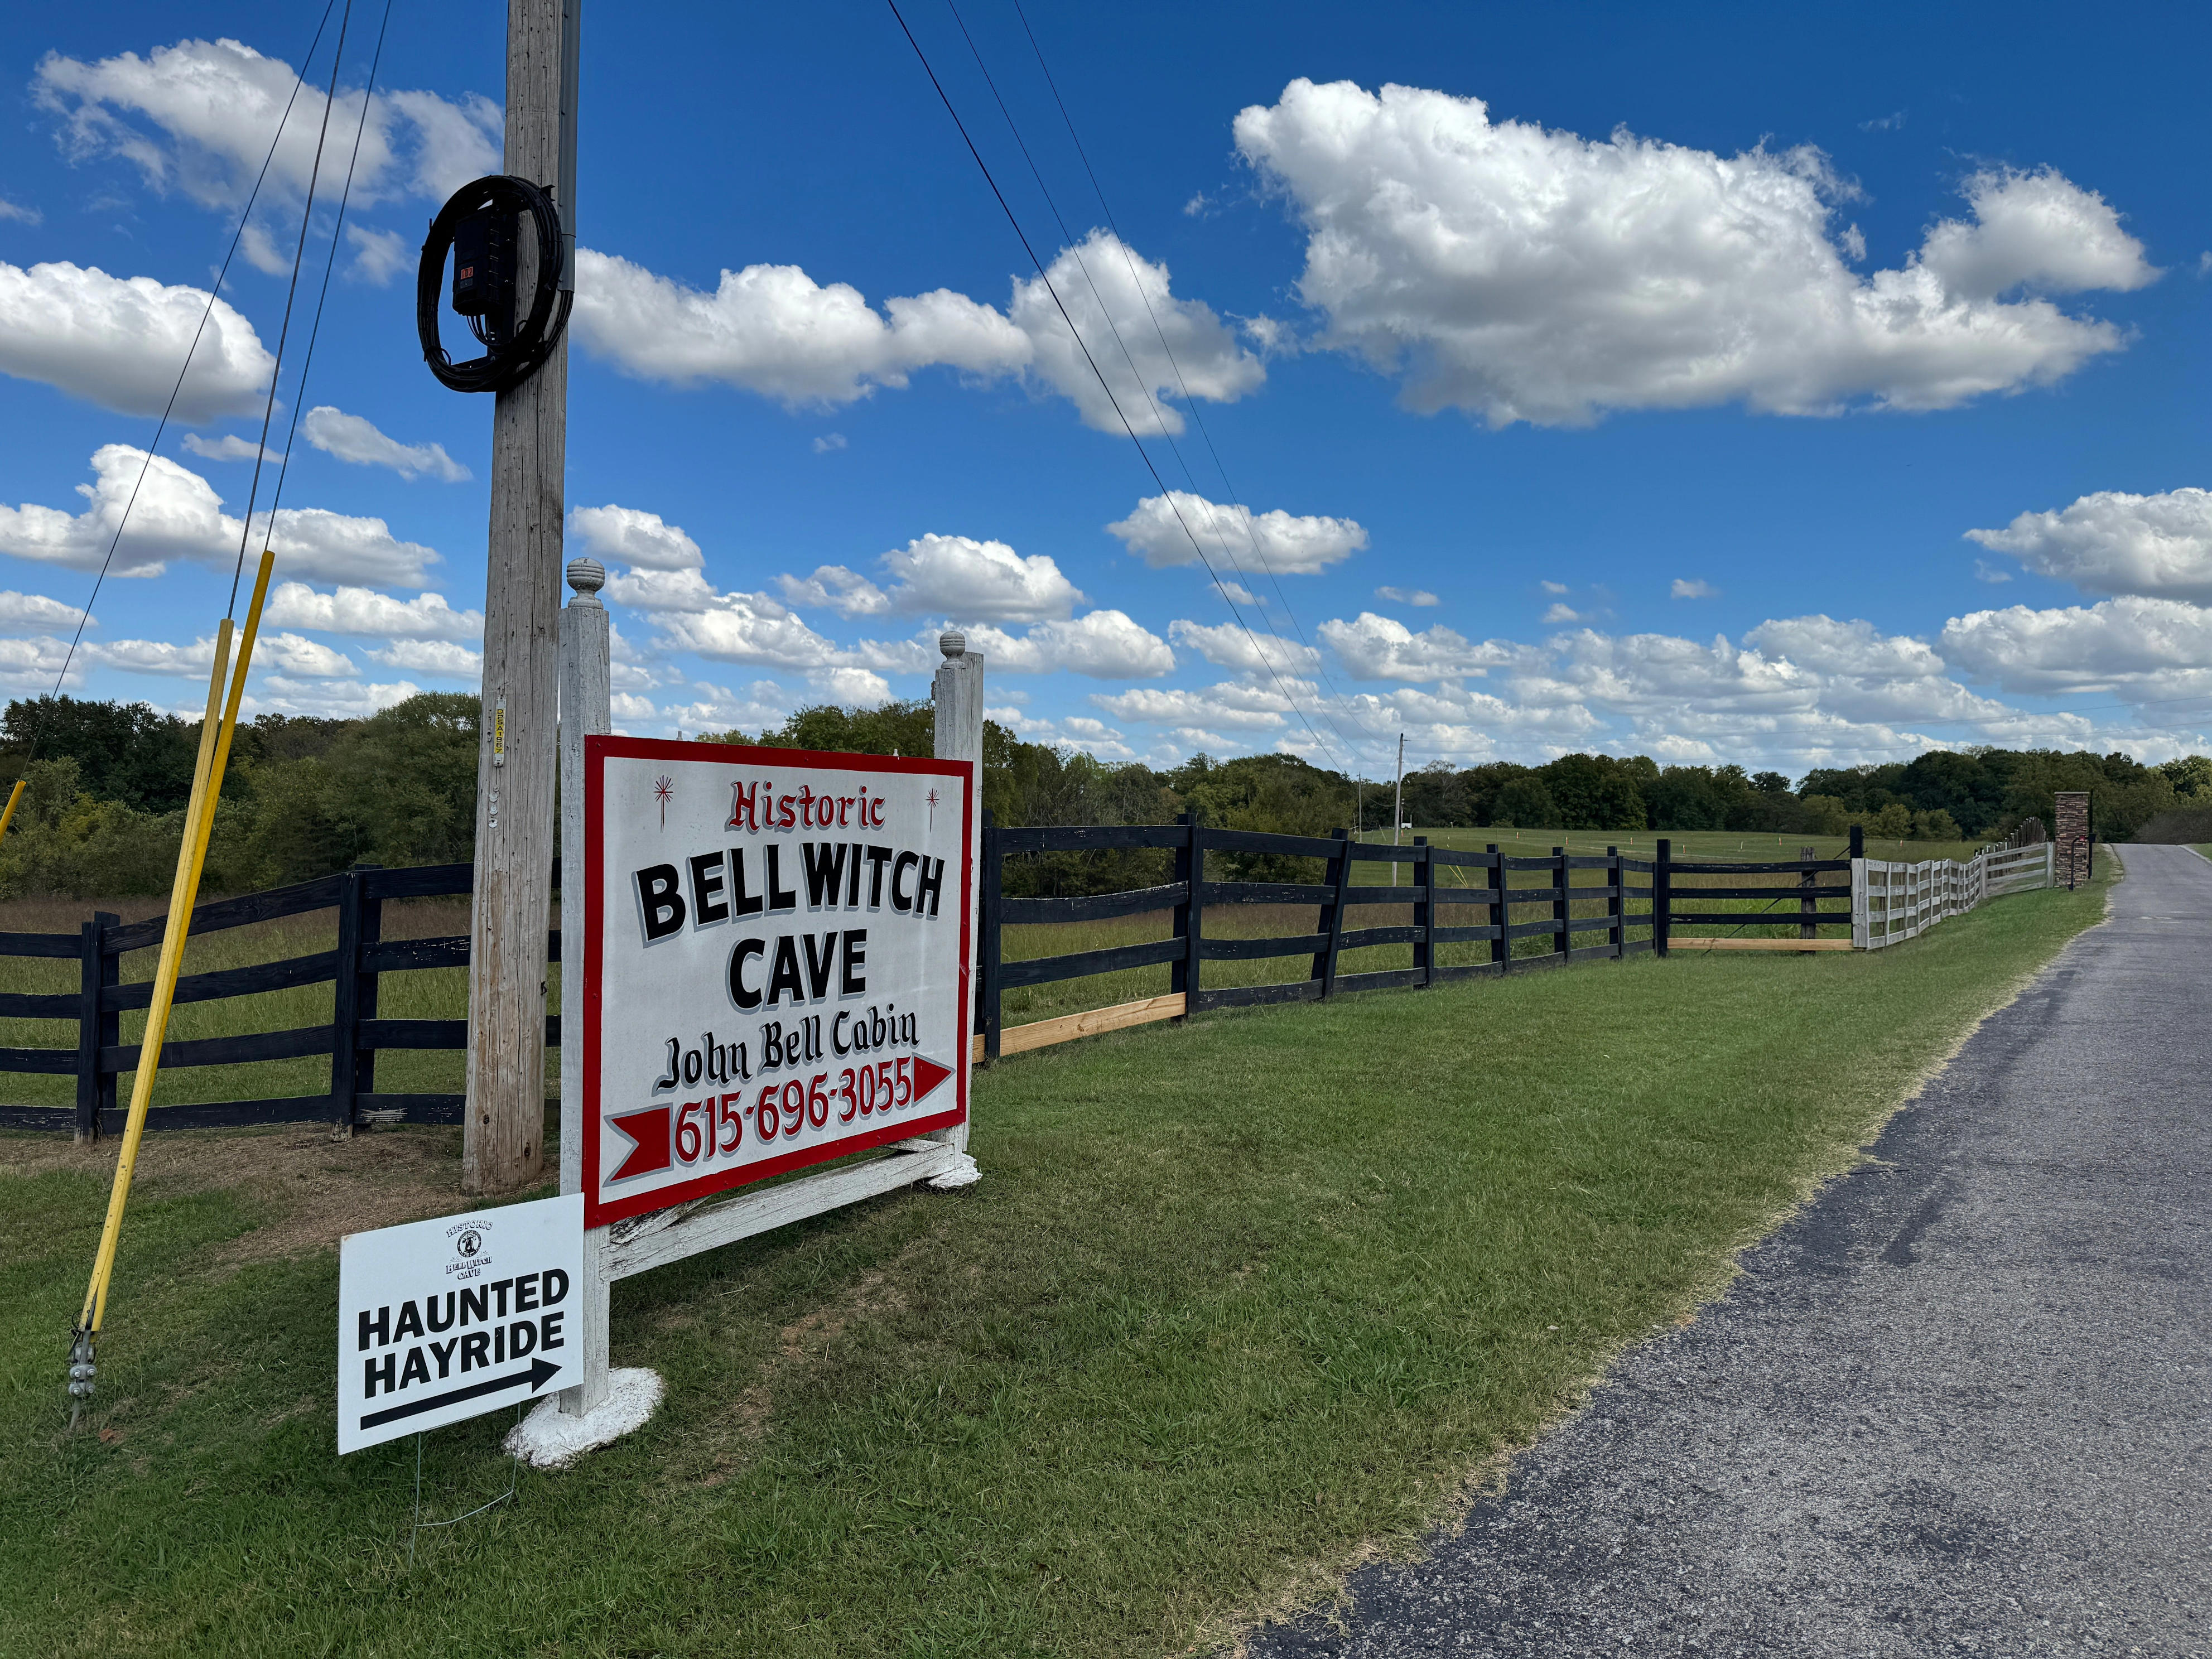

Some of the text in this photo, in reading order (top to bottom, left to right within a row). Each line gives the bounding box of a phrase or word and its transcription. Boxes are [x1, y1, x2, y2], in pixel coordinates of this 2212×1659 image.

[725, 780, 886, 833] Historic
[726, 928, 868, 1014] CAVE
[652, 1003, 921, 1096] John Bell Cabin
[672, 1056, 913, 1167] 615-696-3055
[446, 1220, 493, 1237] HISTORIC
[358, 1269, 570, 1352] HAUNTED
[457, 1268, 481, 1280] CAVE
[364, 1311, 565, 1400] HAYRIDE
